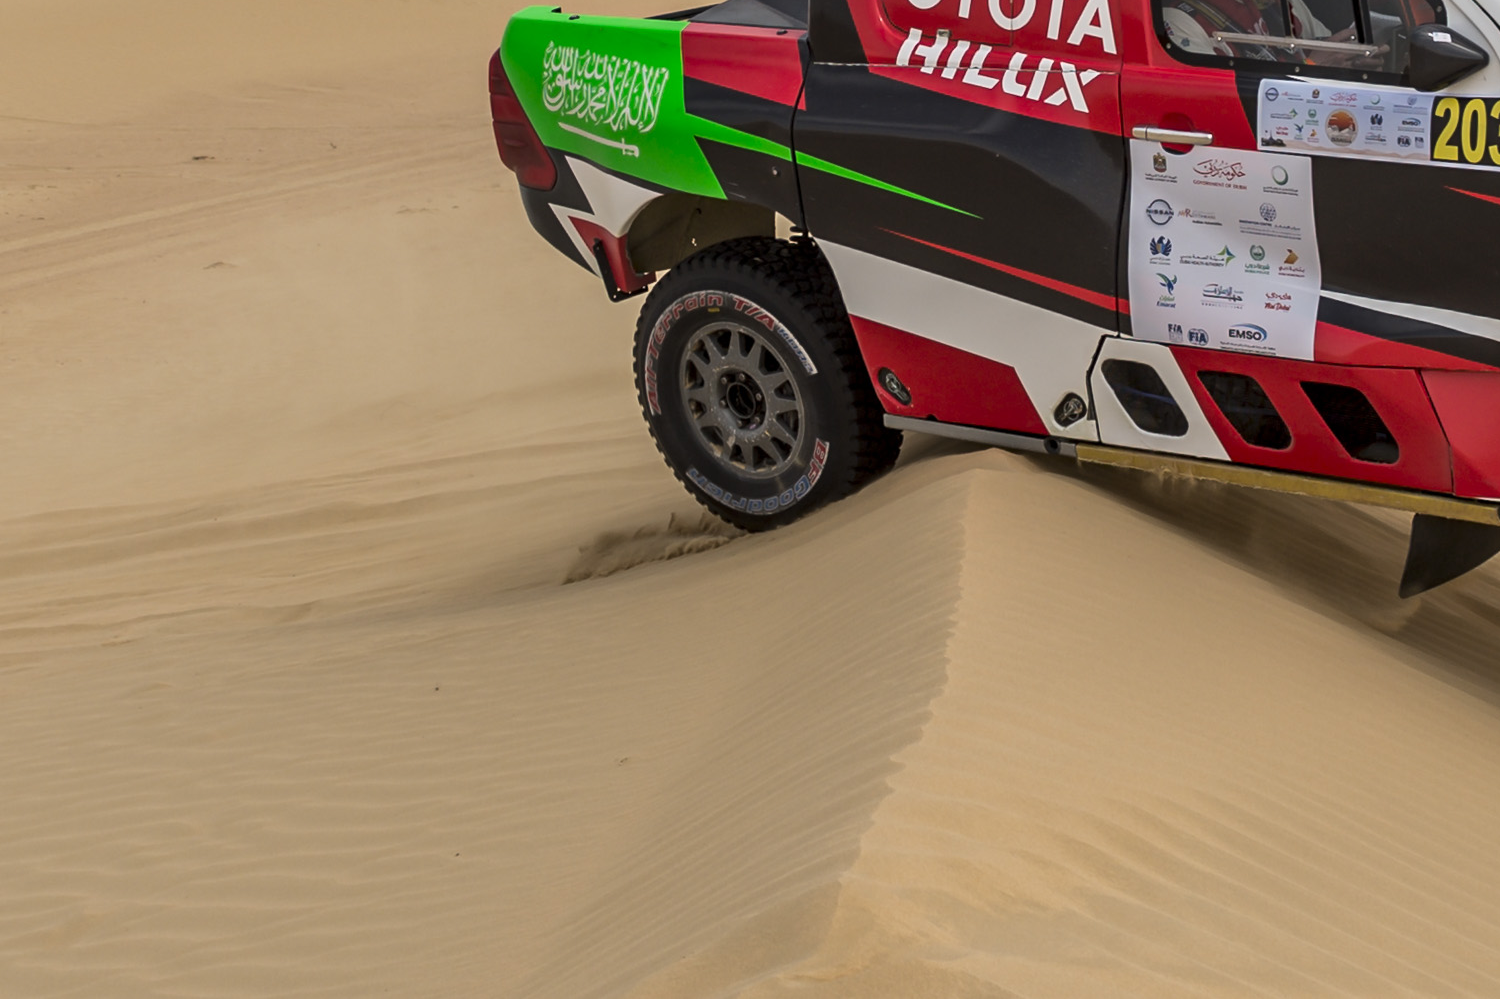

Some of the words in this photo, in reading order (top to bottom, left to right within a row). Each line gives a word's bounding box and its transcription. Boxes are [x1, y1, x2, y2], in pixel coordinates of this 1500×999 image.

[896, 27, 1101, 114] HILUX
[1146, 208, 1174, 217] NISSAN
[1156, 300, 1176, 309] Emarat
[732, 295, 776, 331] T/A
[1168, 323, 1183, 334] FIA
[1188, 329, 1207, 343] FIA
[1229, 329, 1262, 341] EMSO
